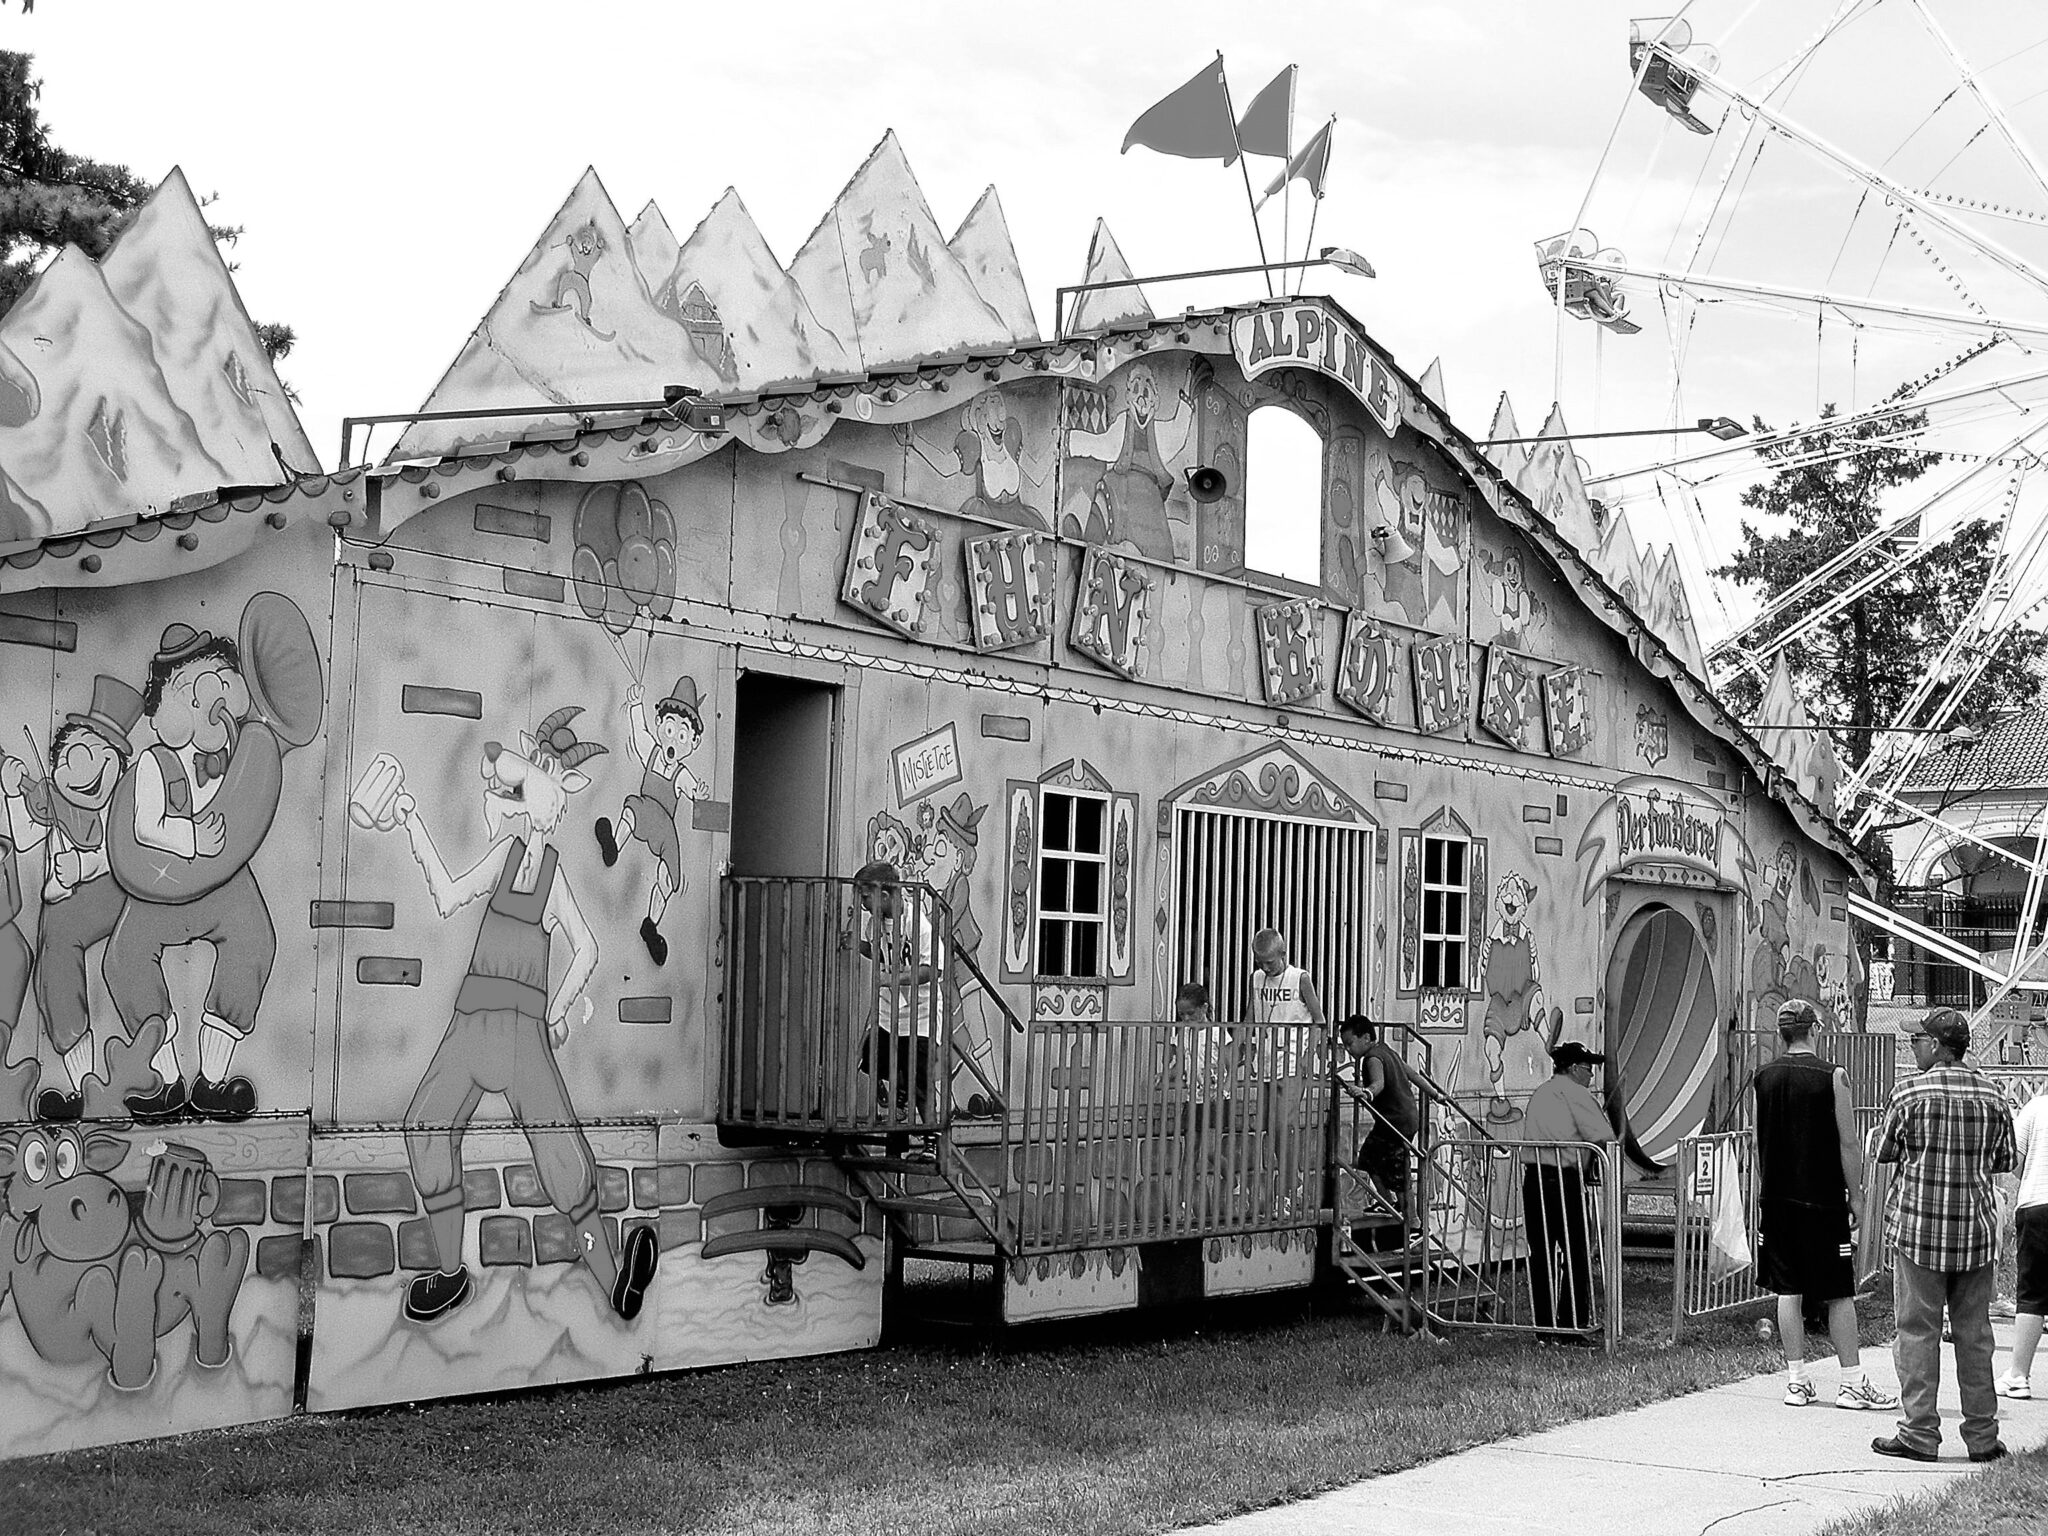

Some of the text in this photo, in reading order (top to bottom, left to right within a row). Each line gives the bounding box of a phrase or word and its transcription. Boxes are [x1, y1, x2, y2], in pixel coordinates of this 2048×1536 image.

[1249, 310, 1389, 421] ALPINE
[860, 507, 1582, 747] FUN HOUSE
[902, 744, 953, 791] MISTLETOE
[1617, 795, 1647, 855] Der
[1671, 792, 1722, 869] Barrel
[1260, 988, 1291, 1002] NIKE
[1702, 1160, 1709, 1176] 2
